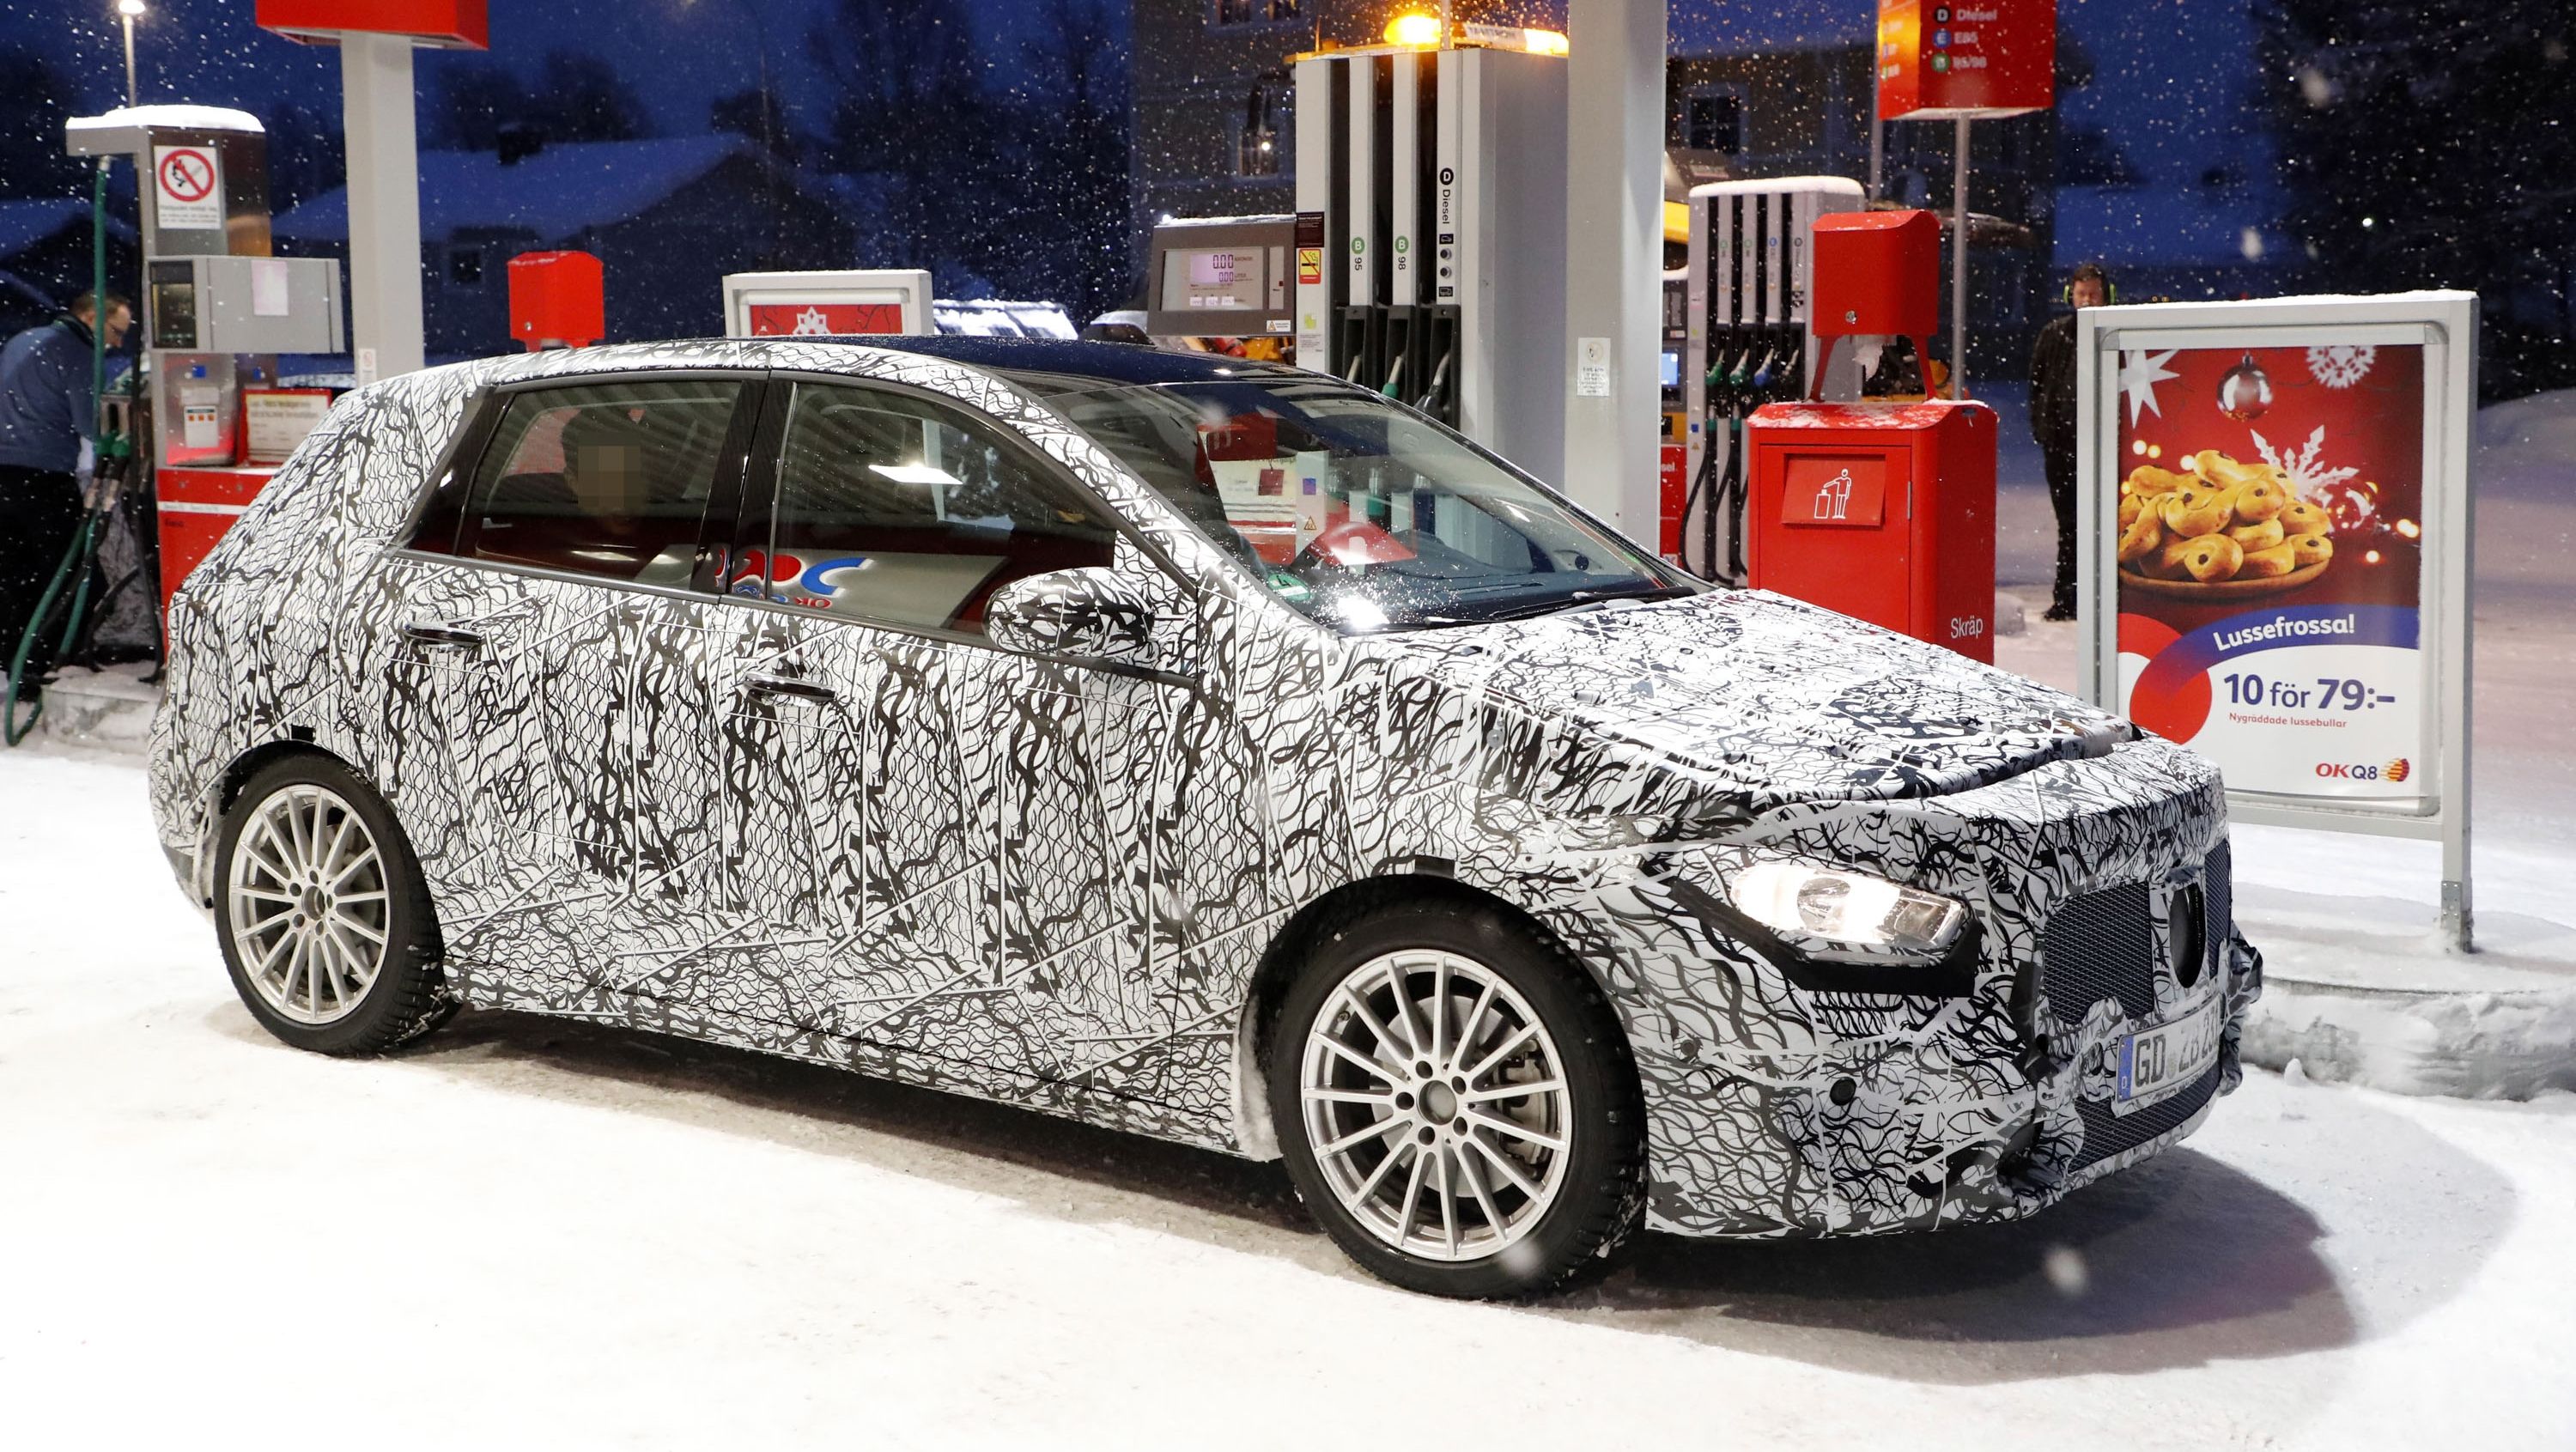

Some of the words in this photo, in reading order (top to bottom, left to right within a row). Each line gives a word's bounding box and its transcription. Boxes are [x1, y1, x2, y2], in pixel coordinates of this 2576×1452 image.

[1956, 9, 1997, 21] Diesel
[1354, 258, 1363, 271] 95
[1398, 257, 1406, 270] 98
[1950, 615, 1984, 640] Skräp
[2213, 613, 2355, 652] Lussefrossa!
[2224, 673, 2264, 706] 10
[2269, 681, 2311, 708] för
[2317, 678, 2396, 711] 79:-
[2229, 712, 2288, 726] Nygräddade
[2290, 716, 2348, 728] lussebullar
[2315, 762, 2349, 779] OK
[2351, 765, 2378, 780] Q8
[2135, 1033, 2166, 1088] GD
